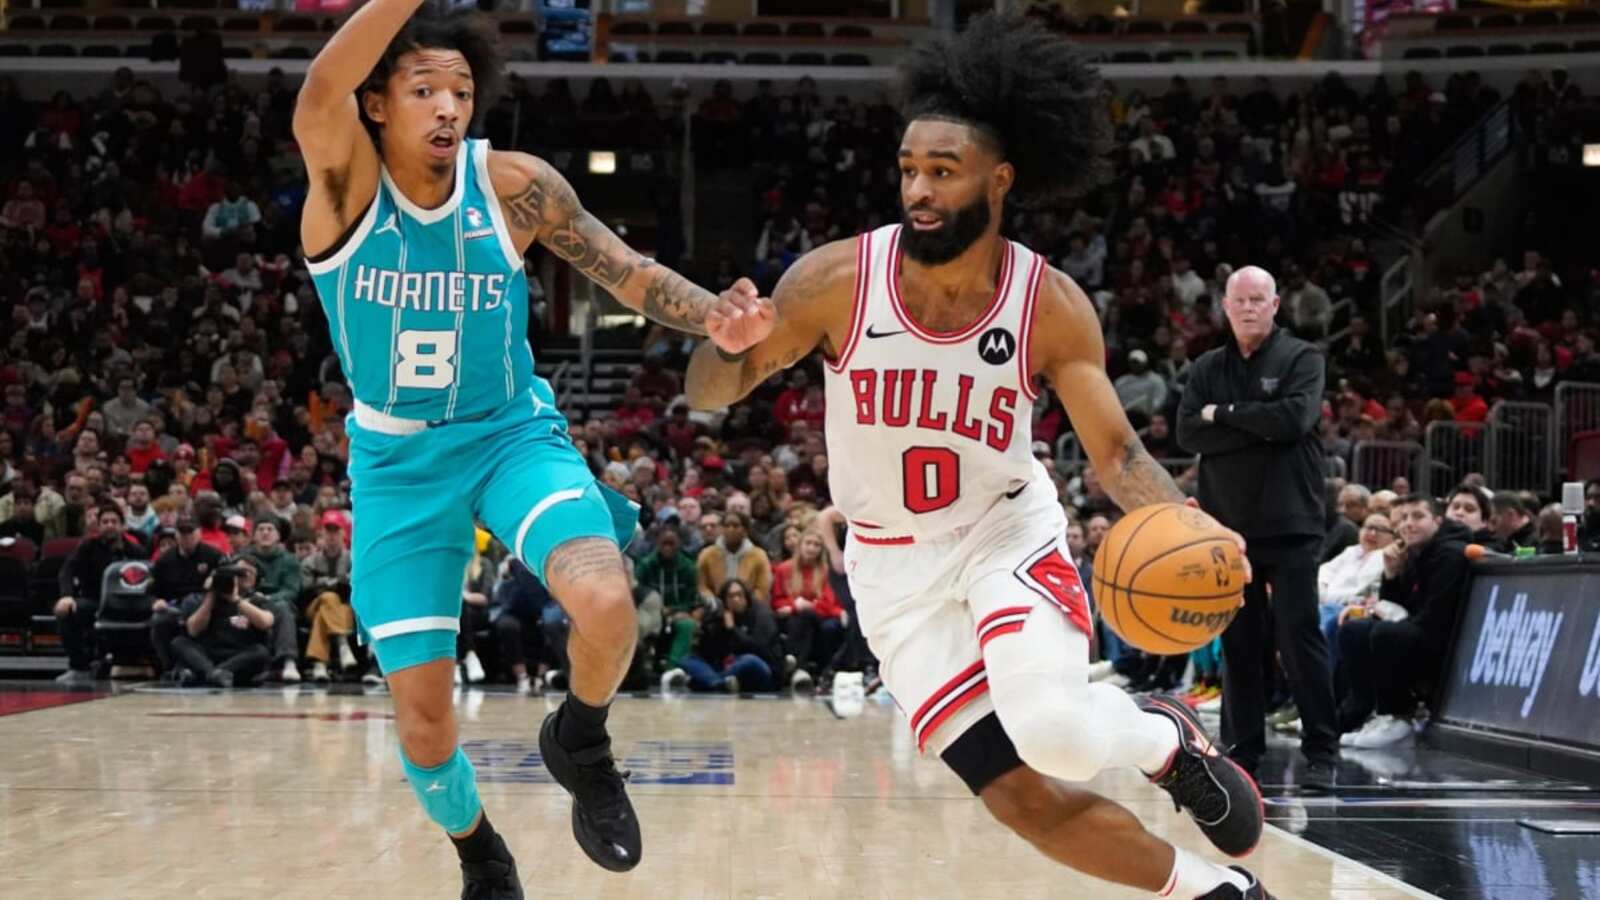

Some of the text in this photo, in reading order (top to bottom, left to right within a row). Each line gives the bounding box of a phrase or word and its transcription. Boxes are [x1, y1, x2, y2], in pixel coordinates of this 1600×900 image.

[354, 264, 505, 312] HORNETS
[395, 329, 457, 389] 8
[850, 368, 1018, 452] BULLS
[902, 445, 961, 514] 0
[1170, 607, 1238, 633] ilson
[1469, 584, 1563, 718] betway
